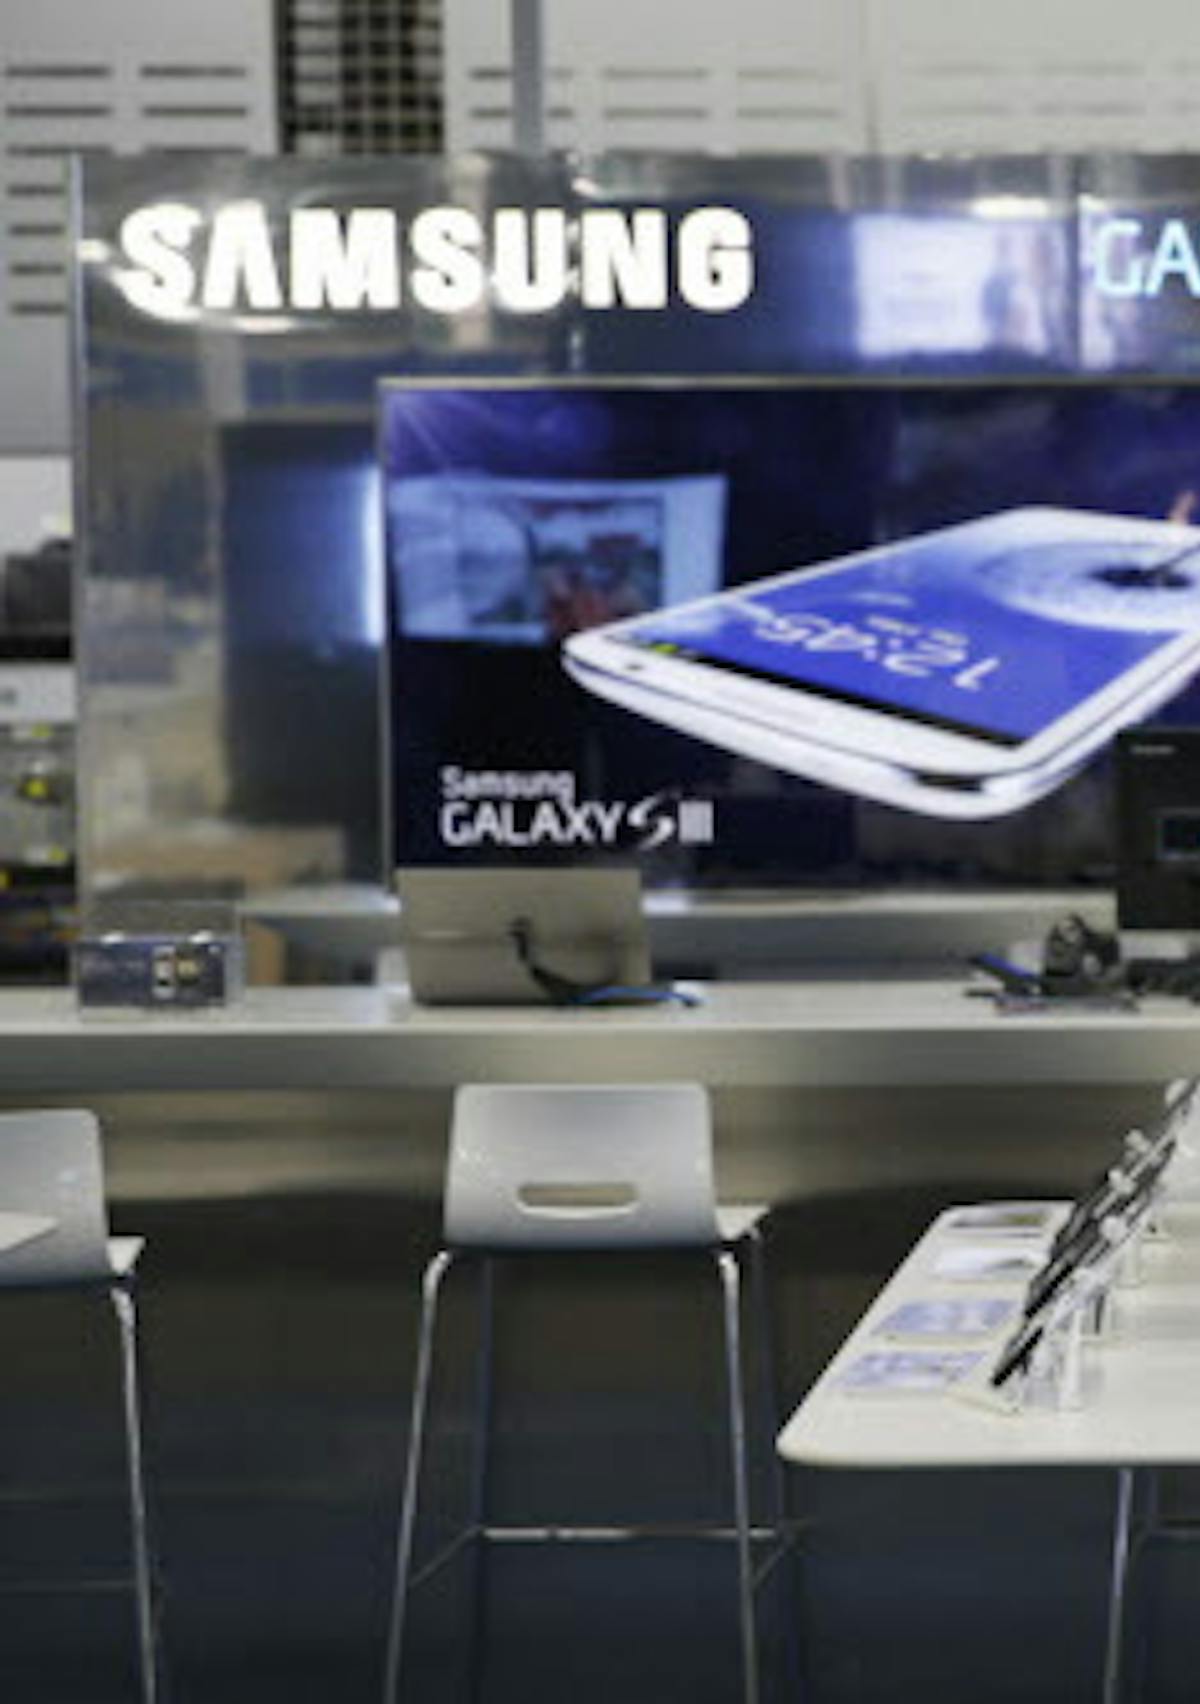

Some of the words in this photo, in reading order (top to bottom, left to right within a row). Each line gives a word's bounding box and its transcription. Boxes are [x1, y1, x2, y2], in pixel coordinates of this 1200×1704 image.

[120, 201, 753, 313] SAMSUNG
[441, 766, 576, 805] Samsung
[441, 800, 626, 846] GALAXY
